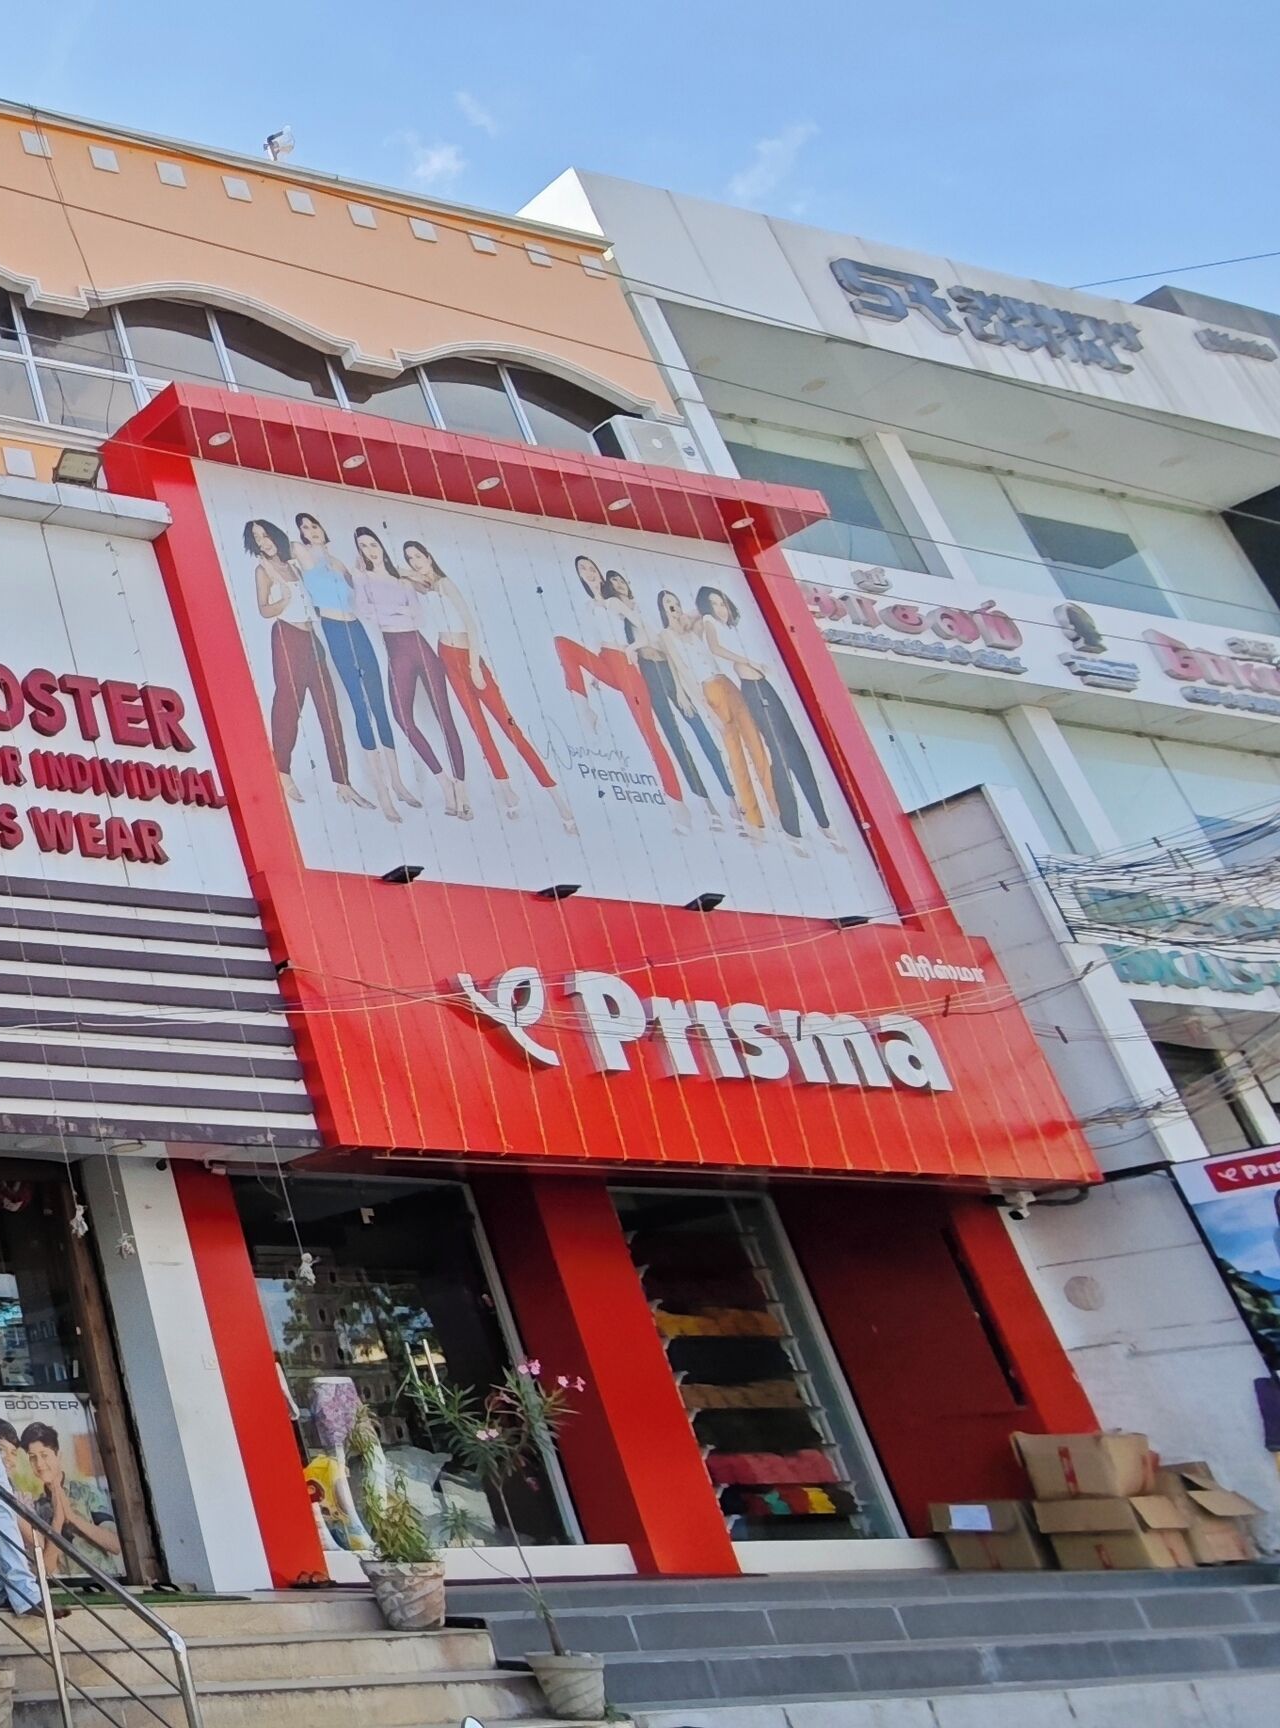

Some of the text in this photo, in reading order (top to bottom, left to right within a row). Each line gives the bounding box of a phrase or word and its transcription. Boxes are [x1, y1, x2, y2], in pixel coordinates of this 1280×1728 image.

[29, 748, 228, 809] INDIVIDUAL
[578, 763, 657, 787] Premium
[612, 785, 666, 806] Brand
[27, 806, 168, 865] WEAR
[564, 969, 954, 1092] Prisma
[4, 1399, 79, 1411] BOOSTER
